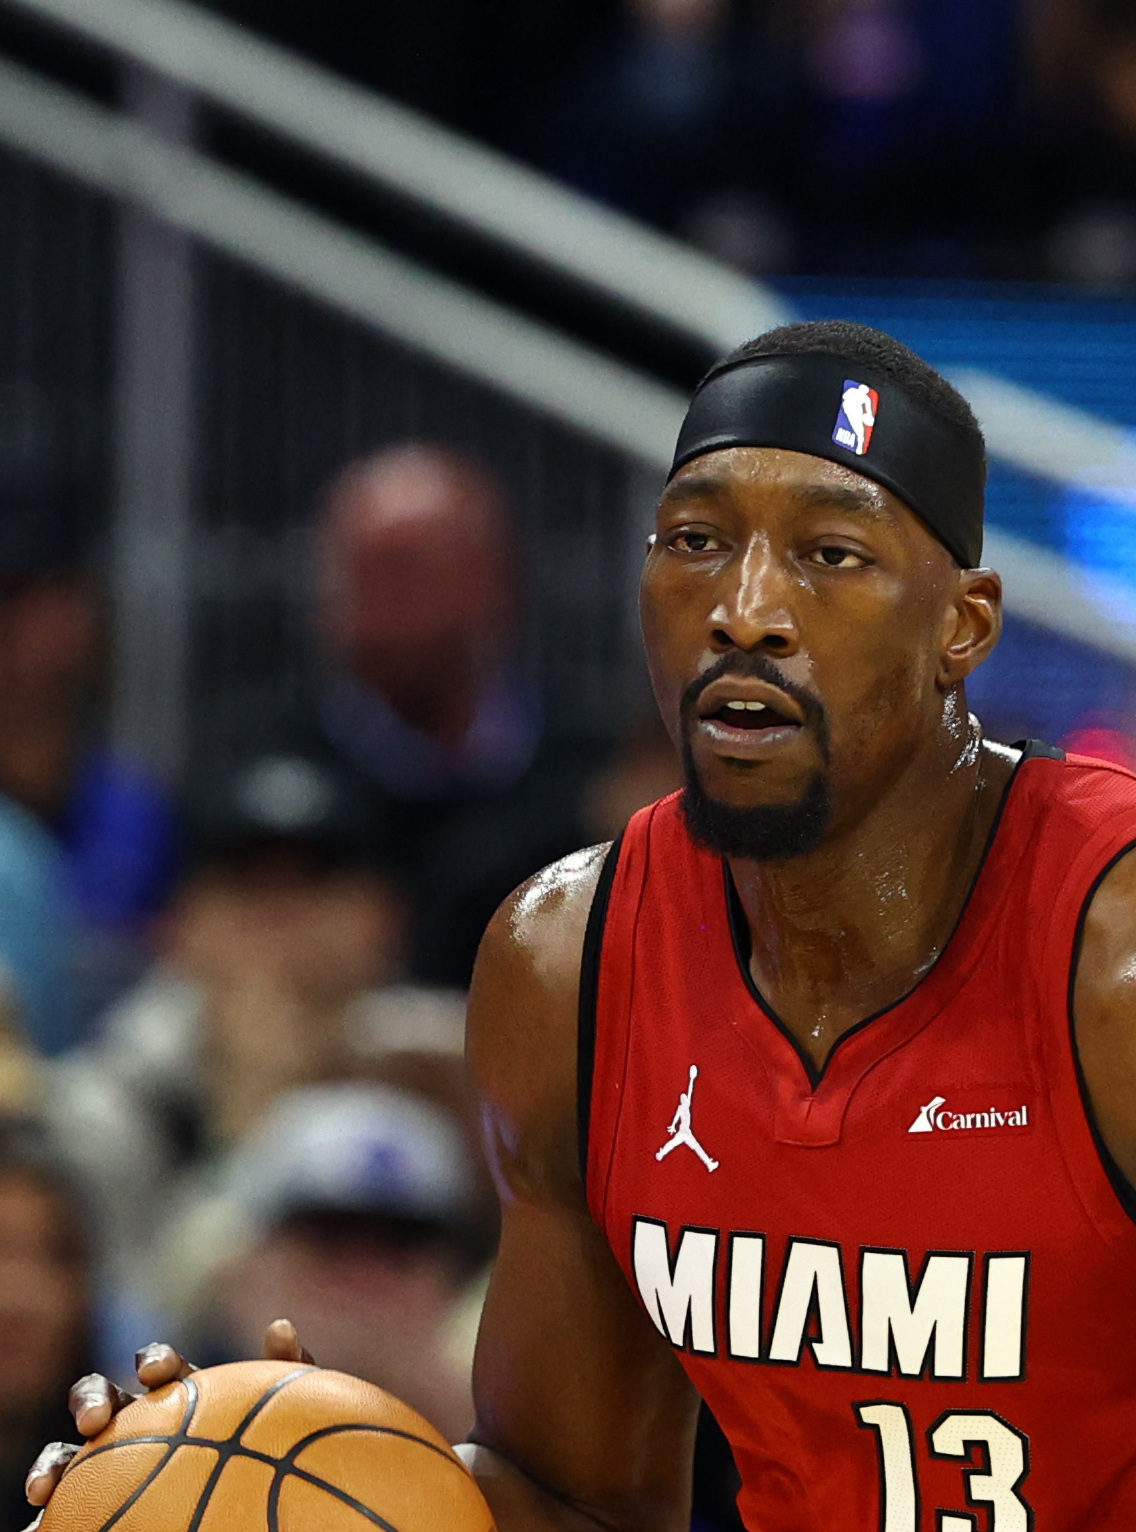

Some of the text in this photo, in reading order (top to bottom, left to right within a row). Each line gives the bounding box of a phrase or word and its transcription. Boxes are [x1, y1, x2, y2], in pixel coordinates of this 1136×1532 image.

[835, 427, 856, 448] NBA
[935, 1105, 1028, 1131] Carnival
[632, 1214, 1030, 1382] MIAMI
